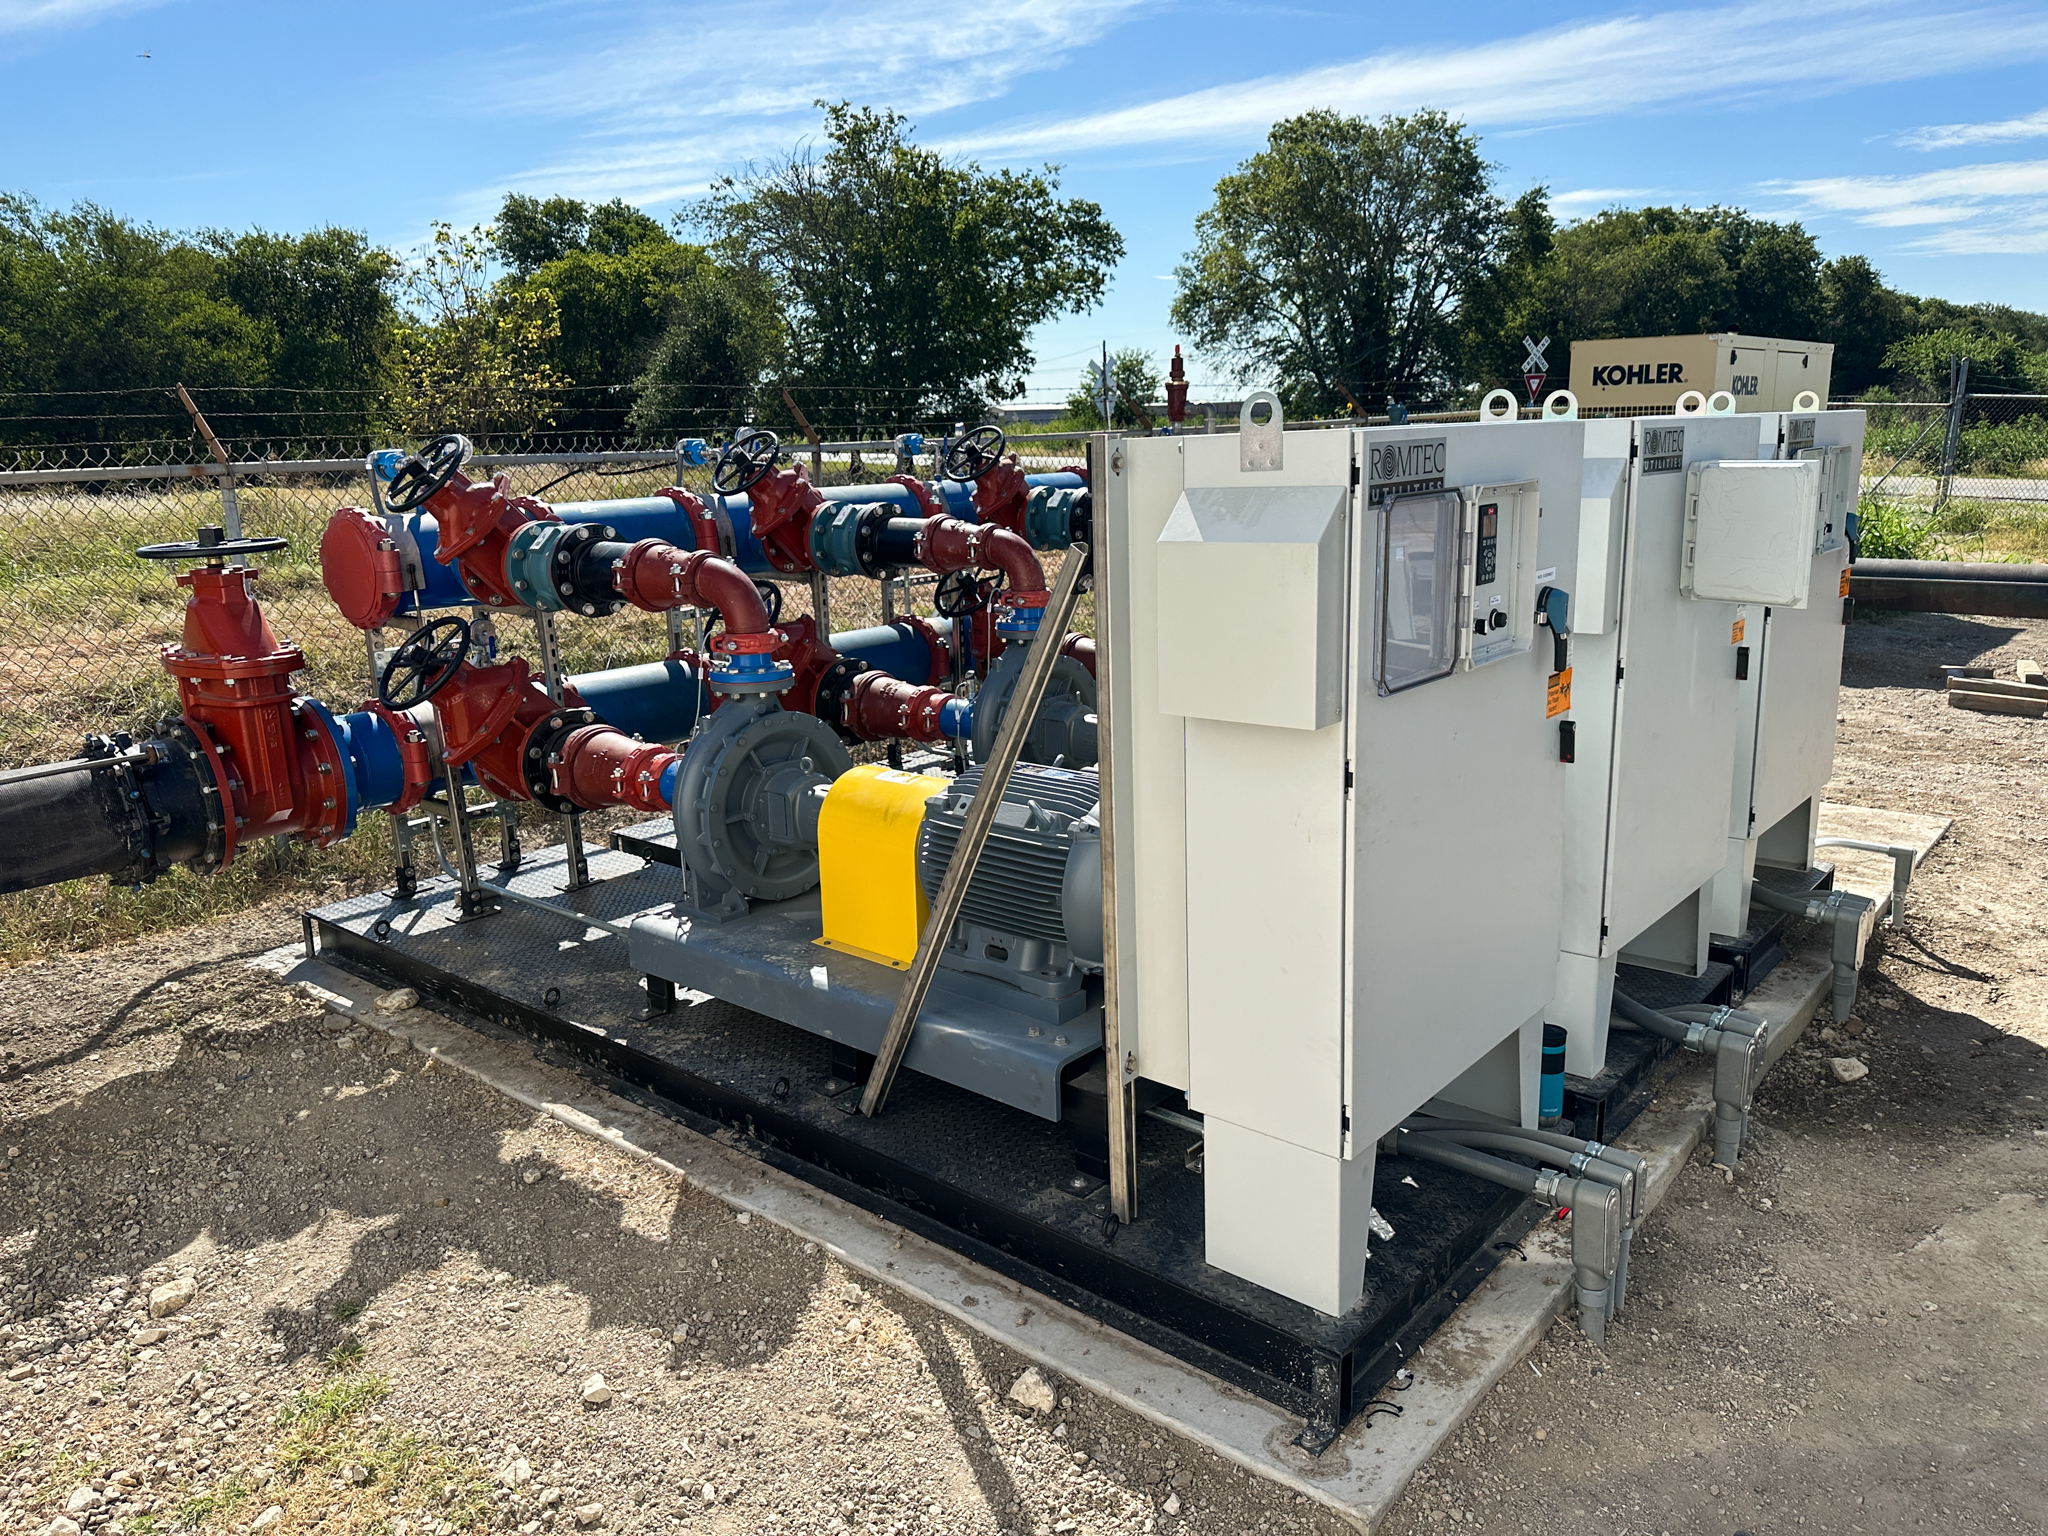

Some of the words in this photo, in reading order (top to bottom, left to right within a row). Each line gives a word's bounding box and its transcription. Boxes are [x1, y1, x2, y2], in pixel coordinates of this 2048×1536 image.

[1523, 338, 1549, 371] CROSSING
[1592, 363, 1683, 386] KOHLER
[1732, 375, 1758, 395] KOHLER
[1644, 430, 1684, 455] ROMTEC
[1370, 442, 1445, 481] ROMTEC
[1644, 458, 1682, 470] UTILITIES
